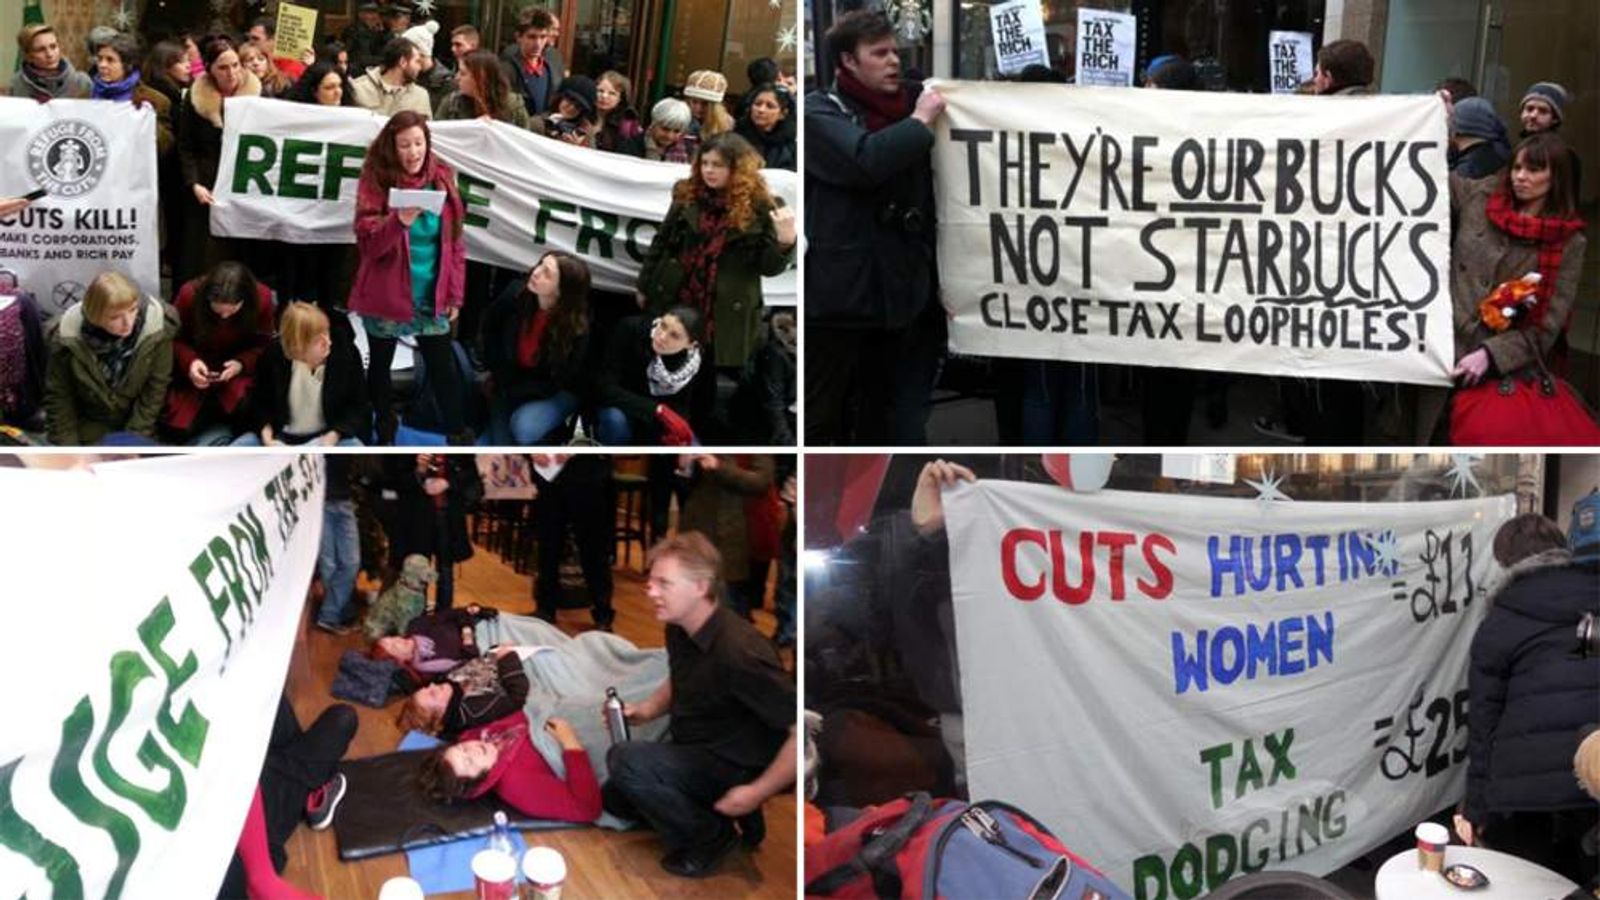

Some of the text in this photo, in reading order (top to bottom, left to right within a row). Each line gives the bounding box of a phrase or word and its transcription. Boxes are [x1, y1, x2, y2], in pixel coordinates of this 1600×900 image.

[996, 11, 1021, 28] TAX
[1083, 21, 1113, 37] TAX
[998, 24, 1025, 41] THE
[999, 38, 1032, 56] RICH
[1083, 37, 1114, 54] THE
[1274, 44, 1296, 58] TAX
[1082, 53, 1119, 70] RICH
[1274, 60, 1297, 74] THE
[78, 125, 107, 159] FROM
[951, 127, 1438, 217] THEY'RE OUR BUCKS
[60, 174, 97, 195] CUTS
[231, 133, 662, 264] REFE FRO
[75, 208, 137, 230] KILL!
[44, 250, 72, 260] AND
[77, 250, 107, 260] RICH
[112, 250, 134, 260] PAY
[990, 213, 1439, 309] NOT STARBUCKS
[980, 293, 1427, 353] CLOSE TAX LOOPHOLES!
[1001, 528, 1177, 604] CUTS
[1171, 612, 1334, 695] WOMEN
[0, 595, 211, 900] UGE
[188, 503, 274, 677] FROM
[1200, 728, 1296, 809] TAX
[1133, 789, 1347, 900] DODGING
